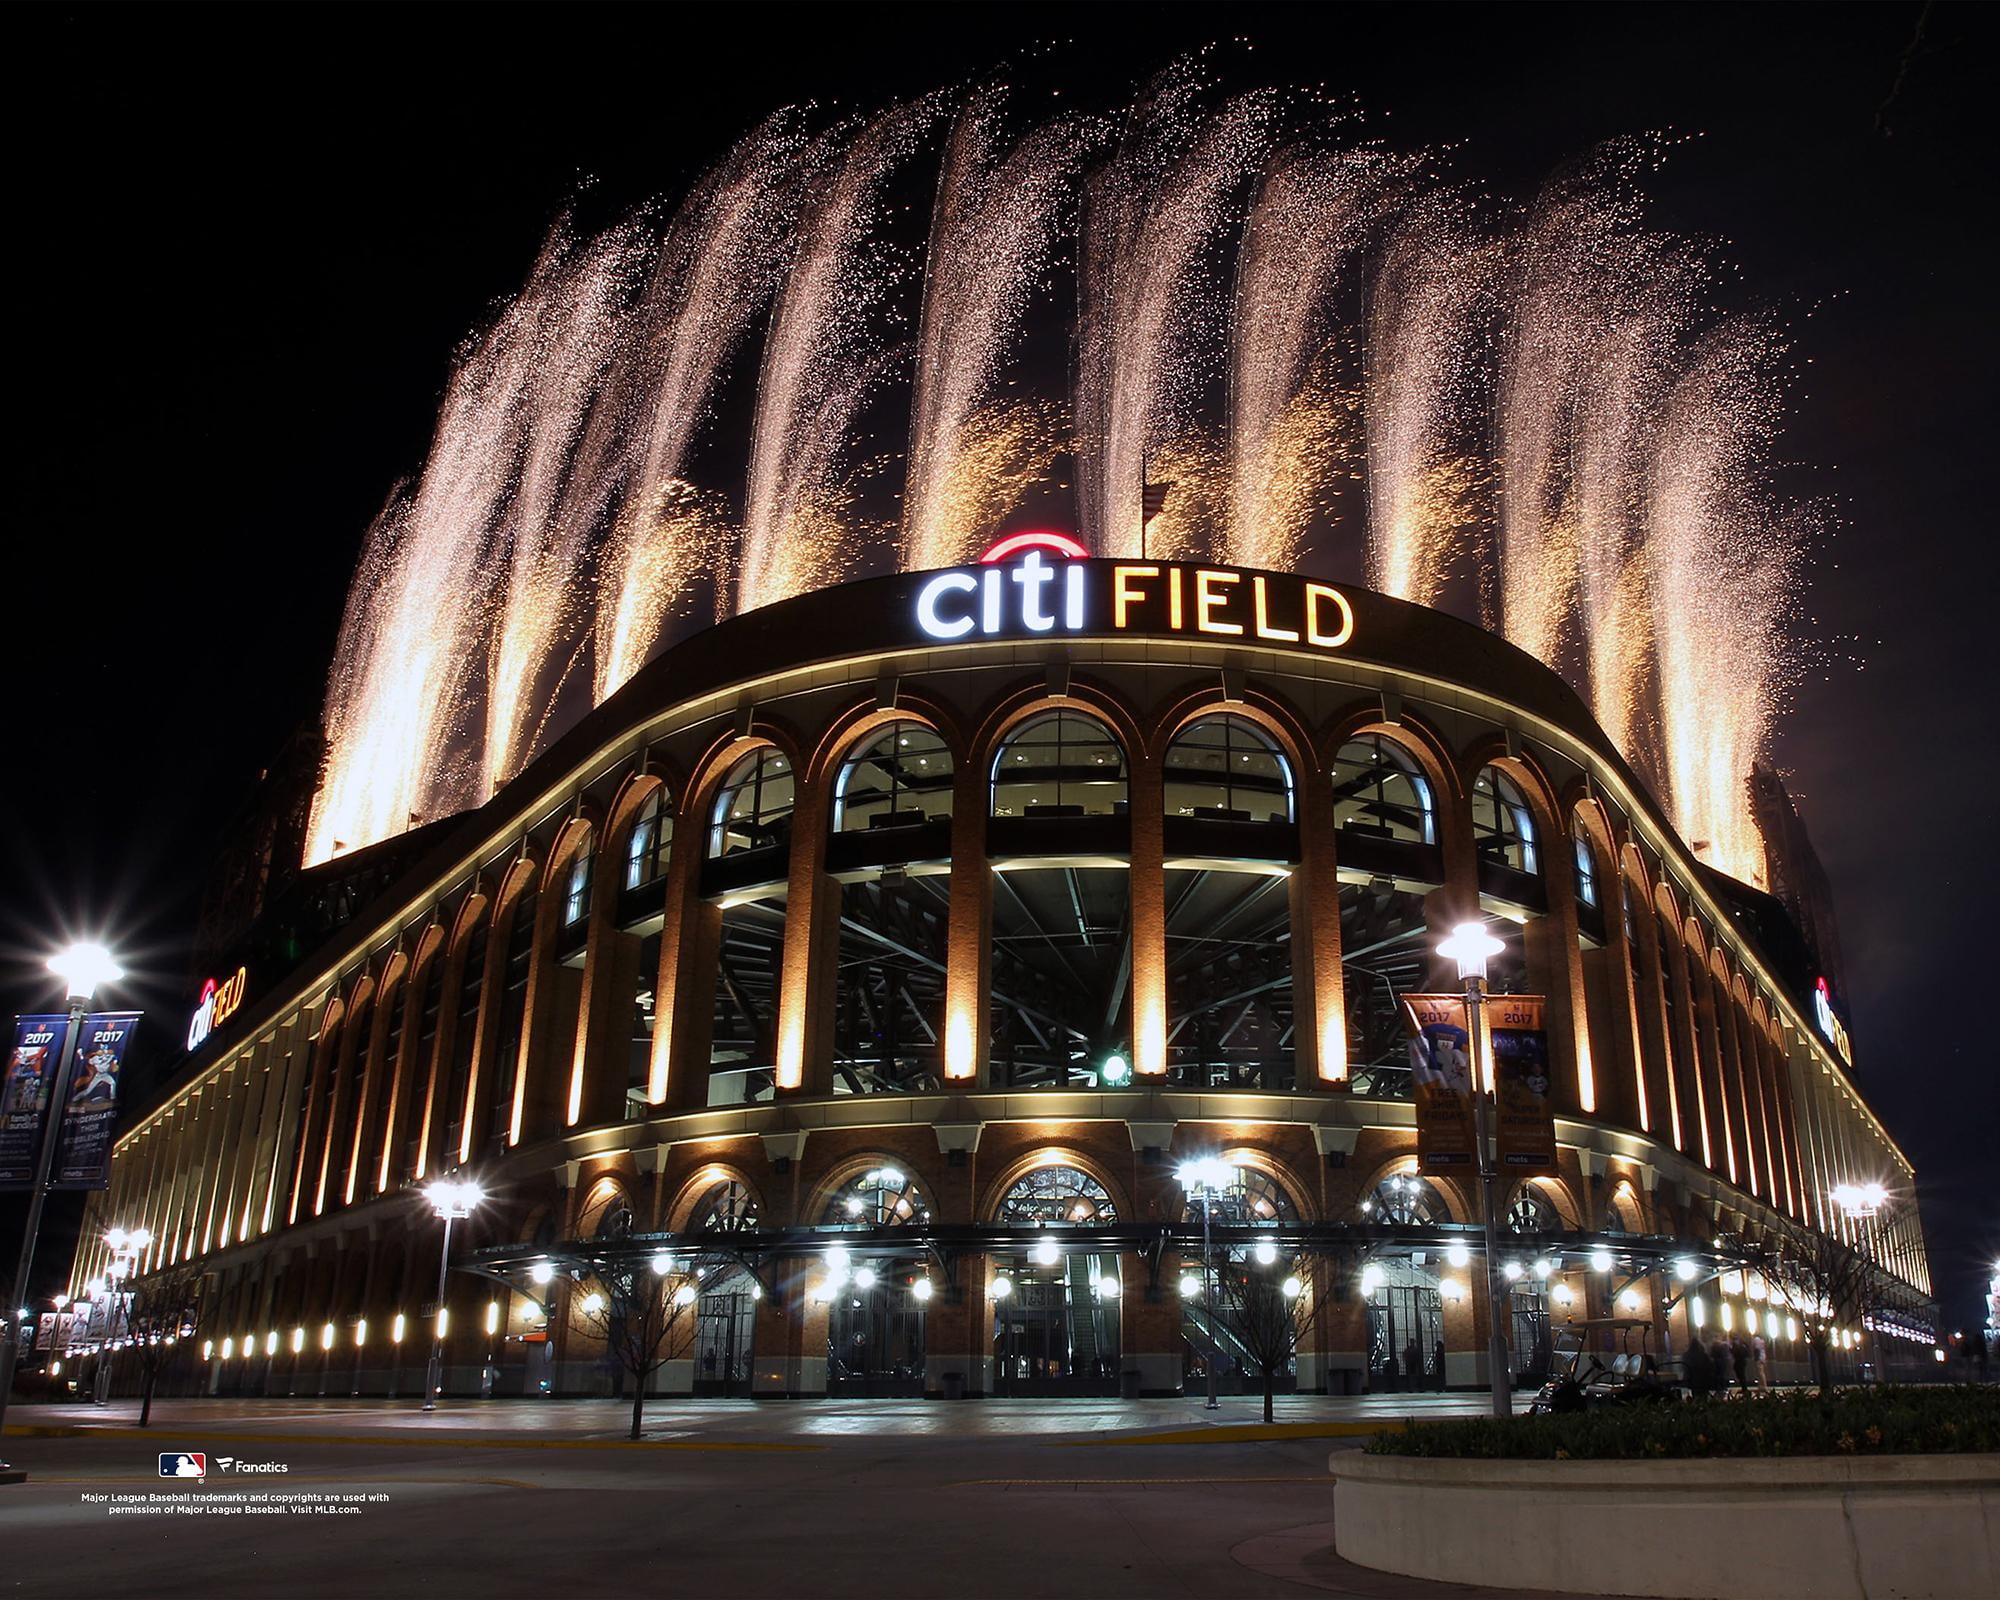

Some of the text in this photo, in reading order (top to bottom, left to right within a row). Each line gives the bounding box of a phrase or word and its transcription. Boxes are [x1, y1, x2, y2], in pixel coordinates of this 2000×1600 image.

[916, 548, 1356, 648] citi FIELD
[1420, 1011, 1450, 1024] 2017
[1504, 1012, 1533, 1024] 2017
[24, 1032, 54, 1045] 2017
[93, 1030, 125, 1043] 2017
